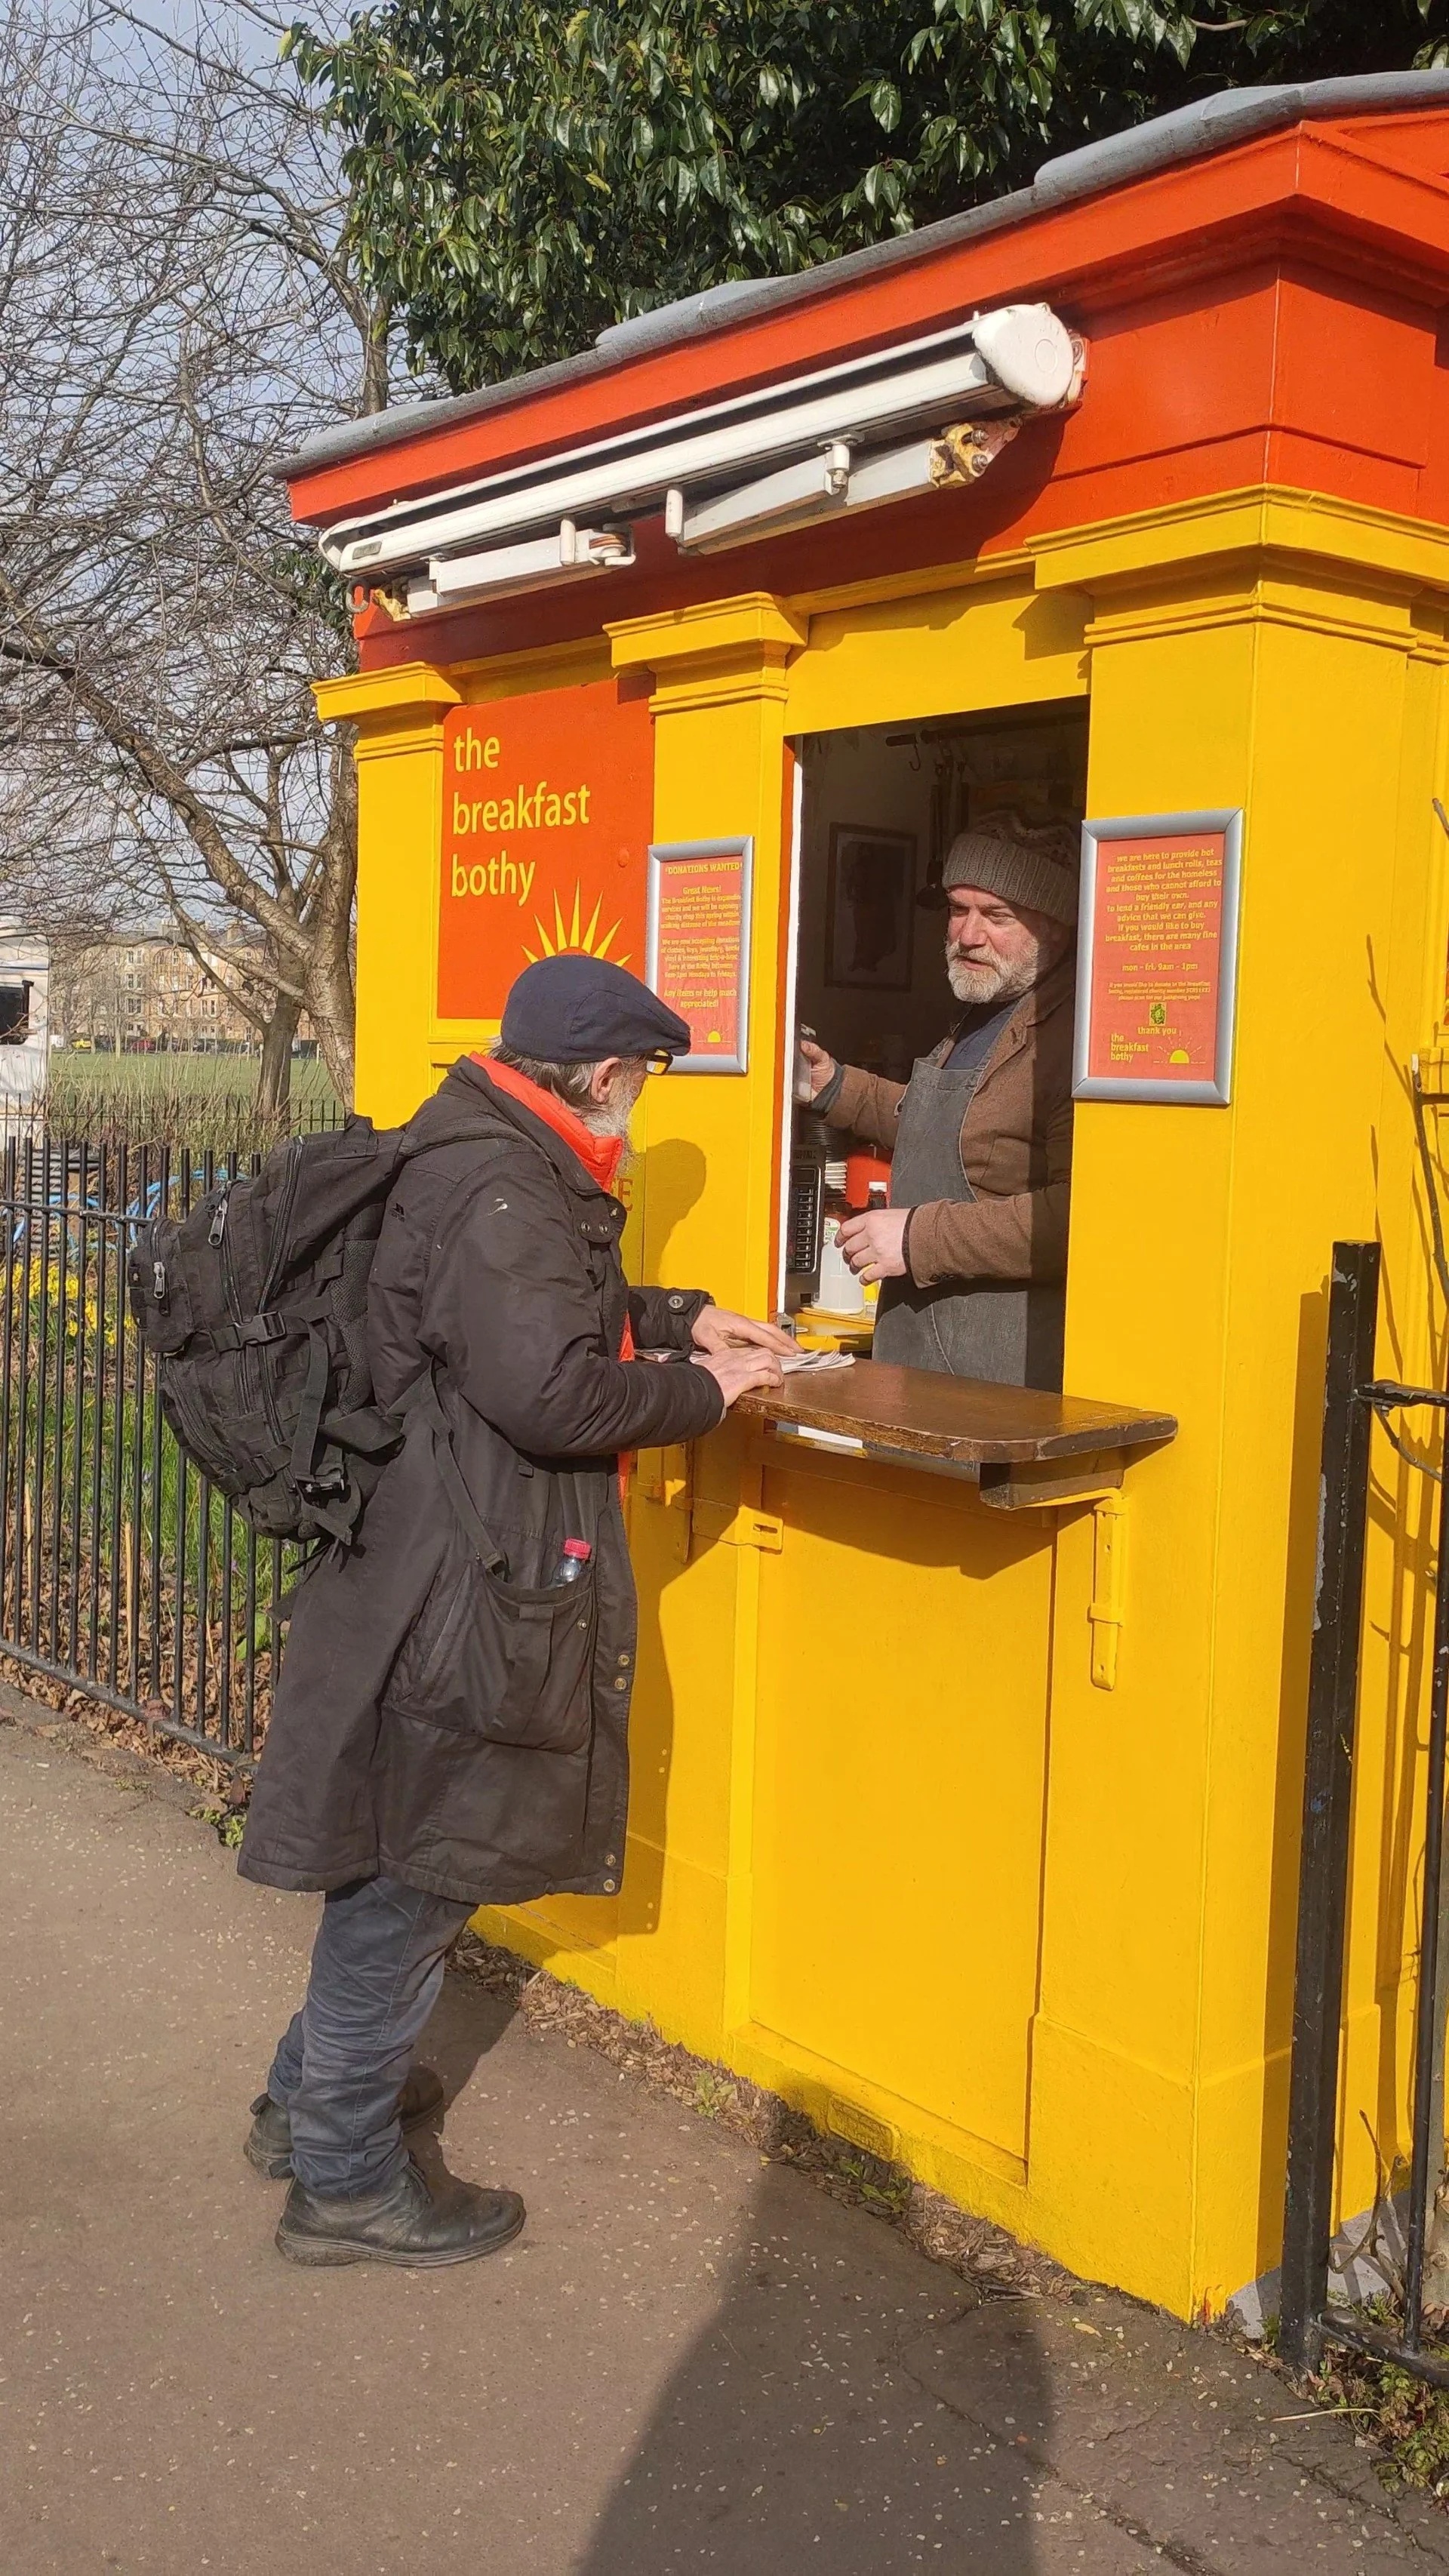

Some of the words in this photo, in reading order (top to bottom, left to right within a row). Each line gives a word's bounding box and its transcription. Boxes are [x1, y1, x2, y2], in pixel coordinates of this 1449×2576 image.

[454, 728, 500, 773] the
[453, 781, 591, 835] breakfast
[1171, 850, 1198, 860] provide
[1108, 864, 1146, 873] breakfasts
[452, 850, 536, 906] bothy
[1127, 873, 1153, 882] coffees
[1136, 894, 1149, 902] buy
[1140, 902, 1170, 912] friendly
[1117, 913, 1141, 922] advice
[1191, 922, 1204, 931] buy
[1180, 932, 1201, 940] many
[1162, 1027, 1177, 1036] you
[1111, 1033, 1124, 1042] the
[1111, 1042, 1149, 1052] breakfast
[1111, 1052, 1133, 1063] bothy
